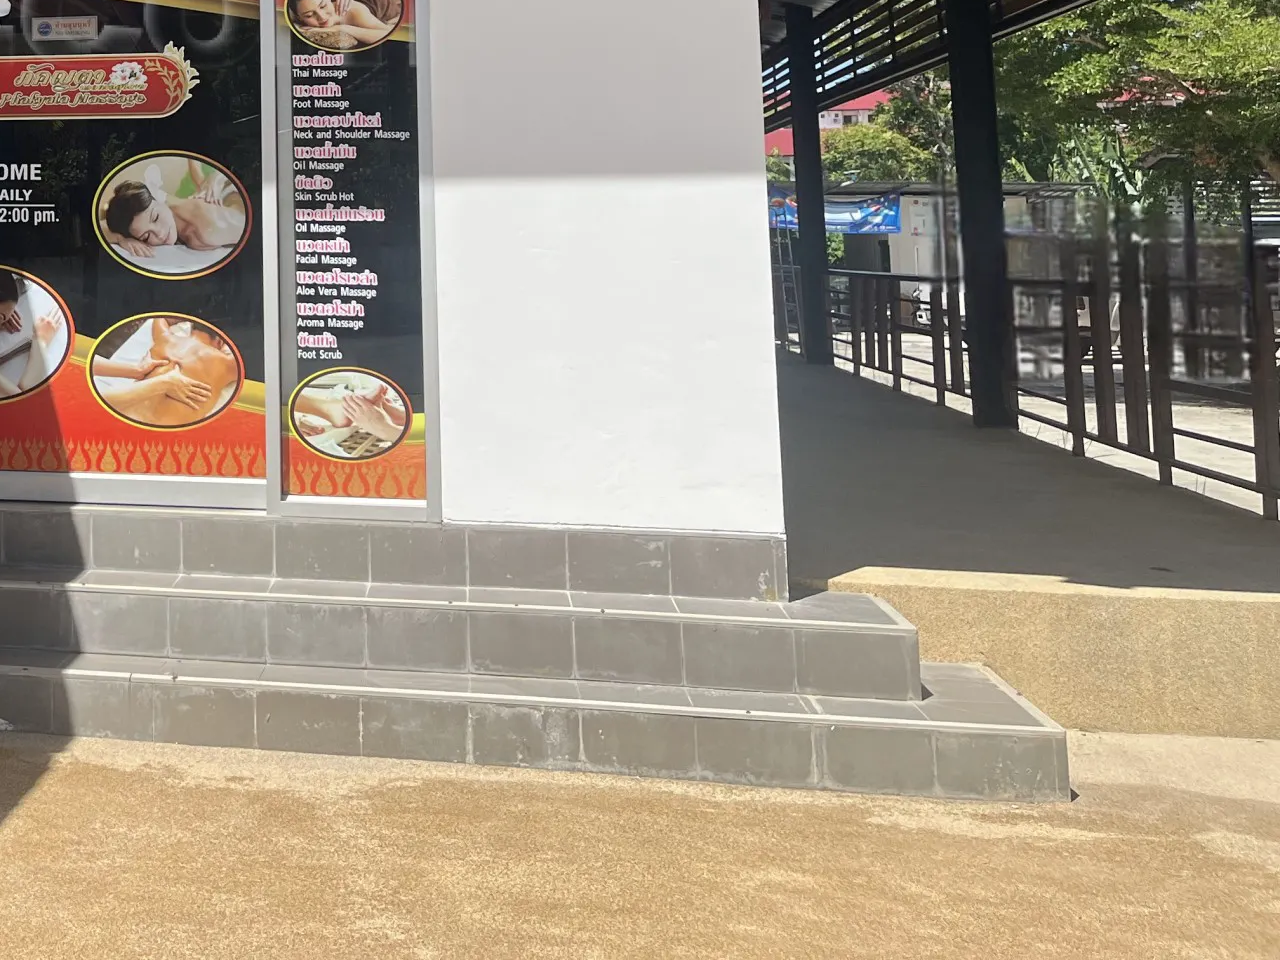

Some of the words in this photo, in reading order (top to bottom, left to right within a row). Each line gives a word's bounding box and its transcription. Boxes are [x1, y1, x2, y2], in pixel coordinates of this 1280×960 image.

[292, 50, 344, 67] นวดไทย
[292, 68, 310, 78] Thai
[312, 68, 348, 79] Massage
[293, 99, 312, 108] Foot
[314, 99, 350, 110] Massage
[293, 130, 314, 139] Neck
[316, 130, 332, 139] and
[335, 130, 371, 139] Shoulder
[374, 130, 410, 141] Massage
[293, 161, 306, 170] Oil
[308, 161, 345, 172] Massage
[295, 192, 312, 201] Skin
[315, 192, 338, 201] Scrub
[339, 192, 355, 201] Hot
[33, 210, 60, 226] pm.
[295, 223, 307, 233] Oil
[310, 223, 346, 235] Massage
[295, 236, 350, 253] นวดหน้า
[295, 254, 318, 264] Facial
[321, 255, 357, 267] Massage
[296, 285, 315, 295] Aloe
[318, 286, 338, 296] Vera
[340, 286, 377, 299] Massage
[297, 318, 325, 328] Aroma
[327, 318, 364, 330] Massage
[297, 349, 317, 359] Foot
[319, 349, 343, 359] Scrub
